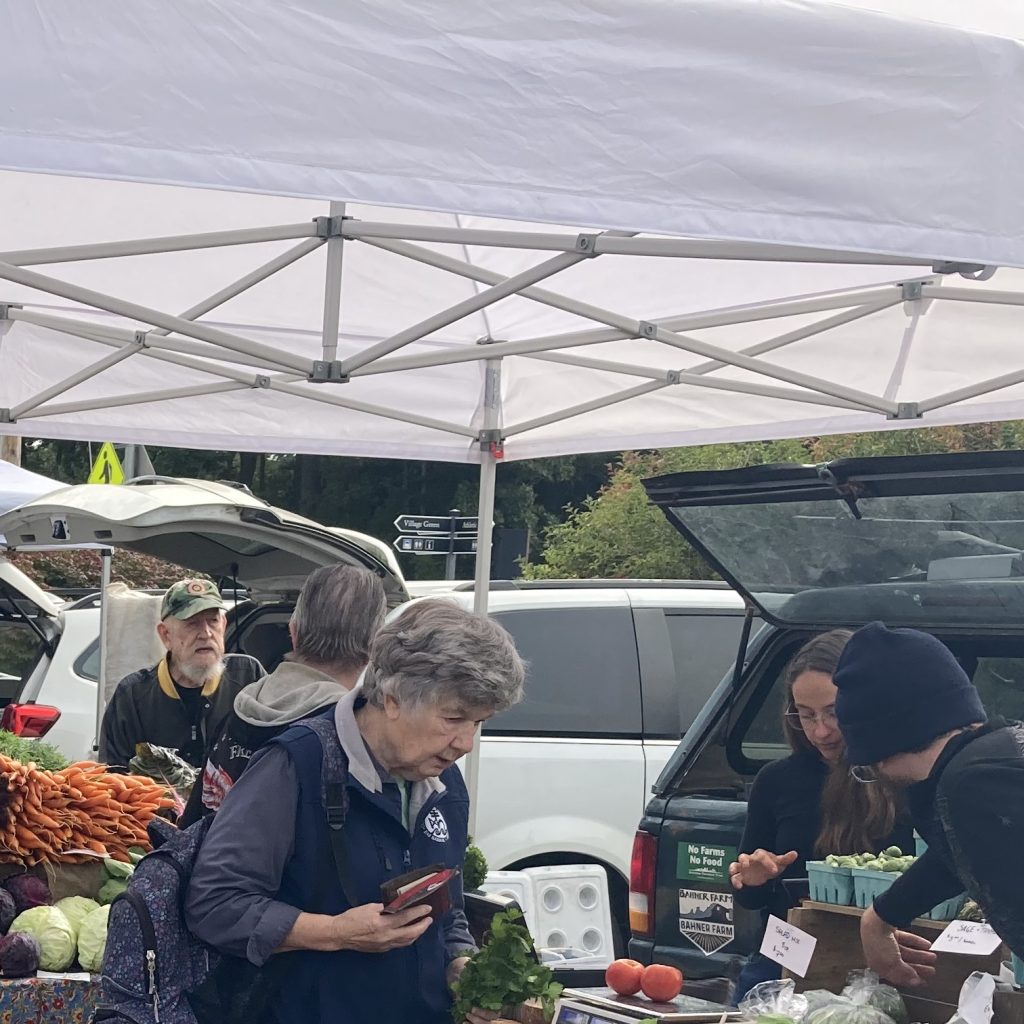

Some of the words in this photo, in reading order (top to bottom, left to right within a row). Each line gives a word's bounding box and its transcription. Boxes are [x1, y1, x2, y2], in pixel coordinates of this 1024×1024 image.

[404, 519, 422, 529] Village
[423, 520, 440, 528] Green
[688, 844, 699, 854] No
[701, 846, 725, 857] Farms
[689, 856, 701, 865] No
[702, 857, 723, 867] Food
[679, 889, 709, 901] BAHNER
[710, 893, 733, 903] FARM
[681, 921, 710, 933] BAHNER
[712, 924, 733, 936] FARM
